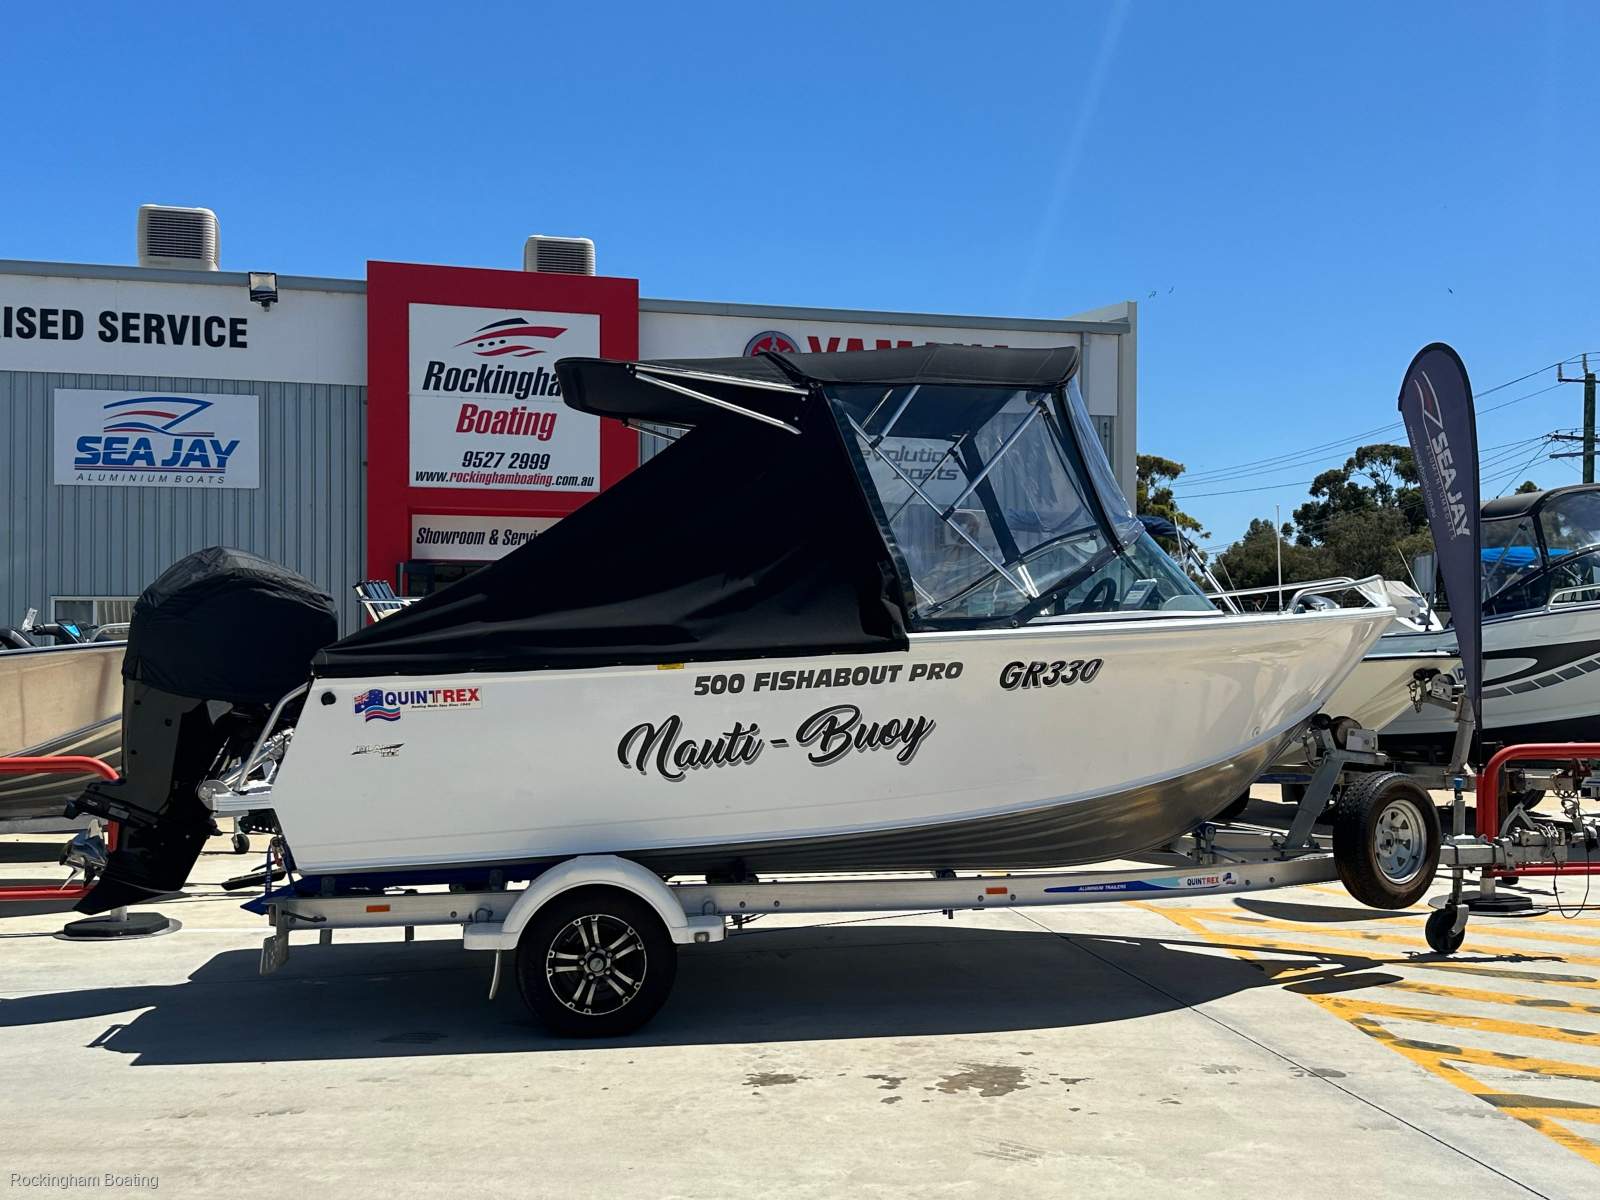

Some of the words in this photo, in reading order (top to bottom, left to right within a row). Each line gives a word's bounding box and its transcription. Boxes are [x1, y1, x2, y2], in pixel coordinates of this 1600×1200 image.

[0, 306, 84, 341] ISED
[98, 310, 248, 349] SERVICE
[422, 360, 561, 400] Rockingha
[455, 403, 557, 442] Boating
[74, 435, 156, 467] SEA
[161, 438, 241, 468] JAY
[461, 450, 505, 469] 9527
[507, 453, 551, 471] 2999
[76, 472, 169, 484] ALUMINIUM
[174, 473, 226, 485] BOATS
[415, 469, 595, 488] www.rockinghamboating.com.au
[1432, 431, 1457, 491] SEA
[1447, 491, 1471, 536] JAY
[416, 527, 486, 546] Showroom
[488, 529, 499, 546] &
[694, 674, 745, 695] 500
[753, 665, 903, 691] FISHABOUT
[908, 661, 963, 682] PRO
[999, 658, 1103, 690] GR330
[384, 688, 480, 705] QUINTREX
[617, 714, 764, 782] Nauti
[795, 704, 936, 766] Buoy
[1186, 876, 1220, 886] QUINTREX
